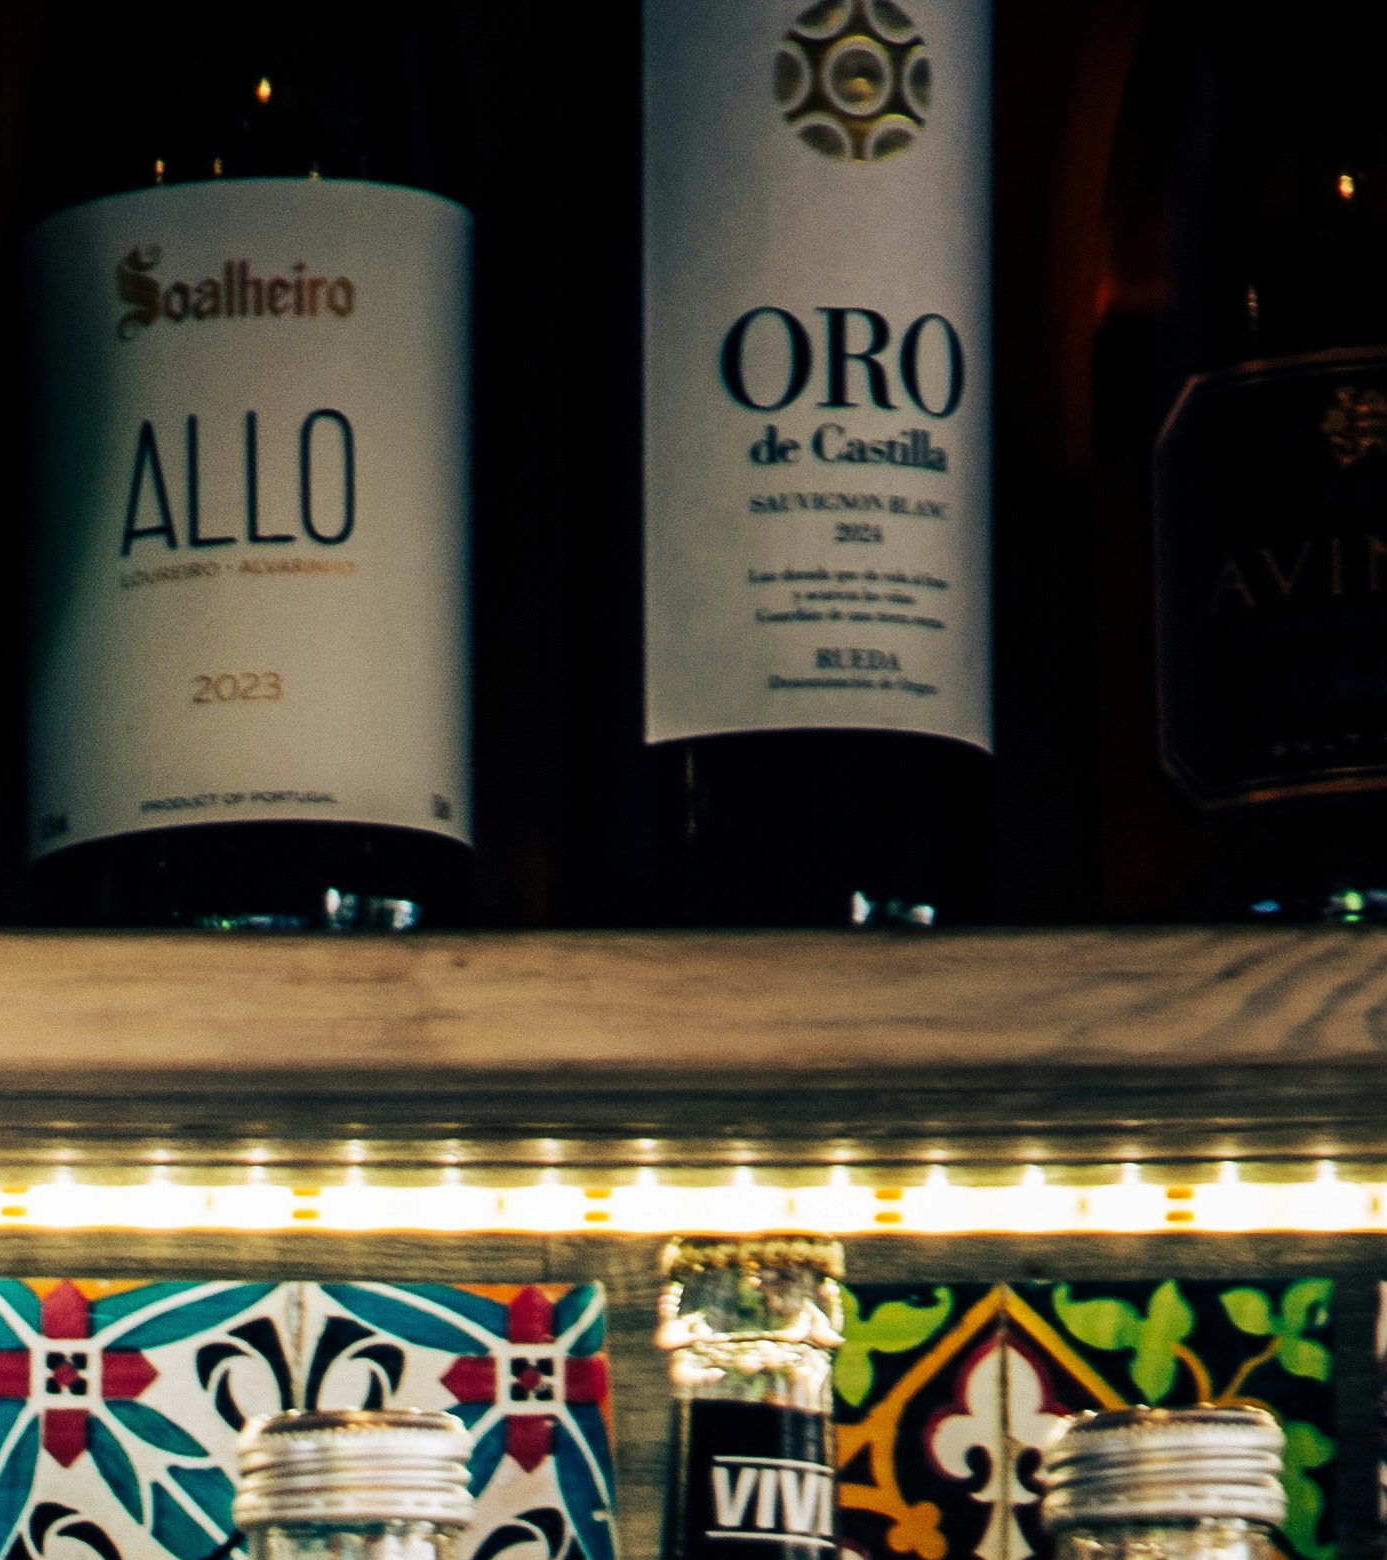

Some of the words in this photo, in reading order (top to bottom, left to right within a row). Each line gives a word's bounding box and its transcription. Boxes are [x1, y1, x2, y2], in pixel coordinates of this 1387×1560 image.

[115, 242, 358, 343] Soalheiro
[718, 305, 965, 419] ORO
[749, 423, 801, 466] de
[811, 422, 947, 472] Castilla
[120, 408, 357, 560] ALLO
[748, 492, 884, 514] SAUVIGNON
[192, 670, 283, 704] 2023
[815, 647, 902, 672] RUEDA
[710, 1464, 833, 1537] VIVI
